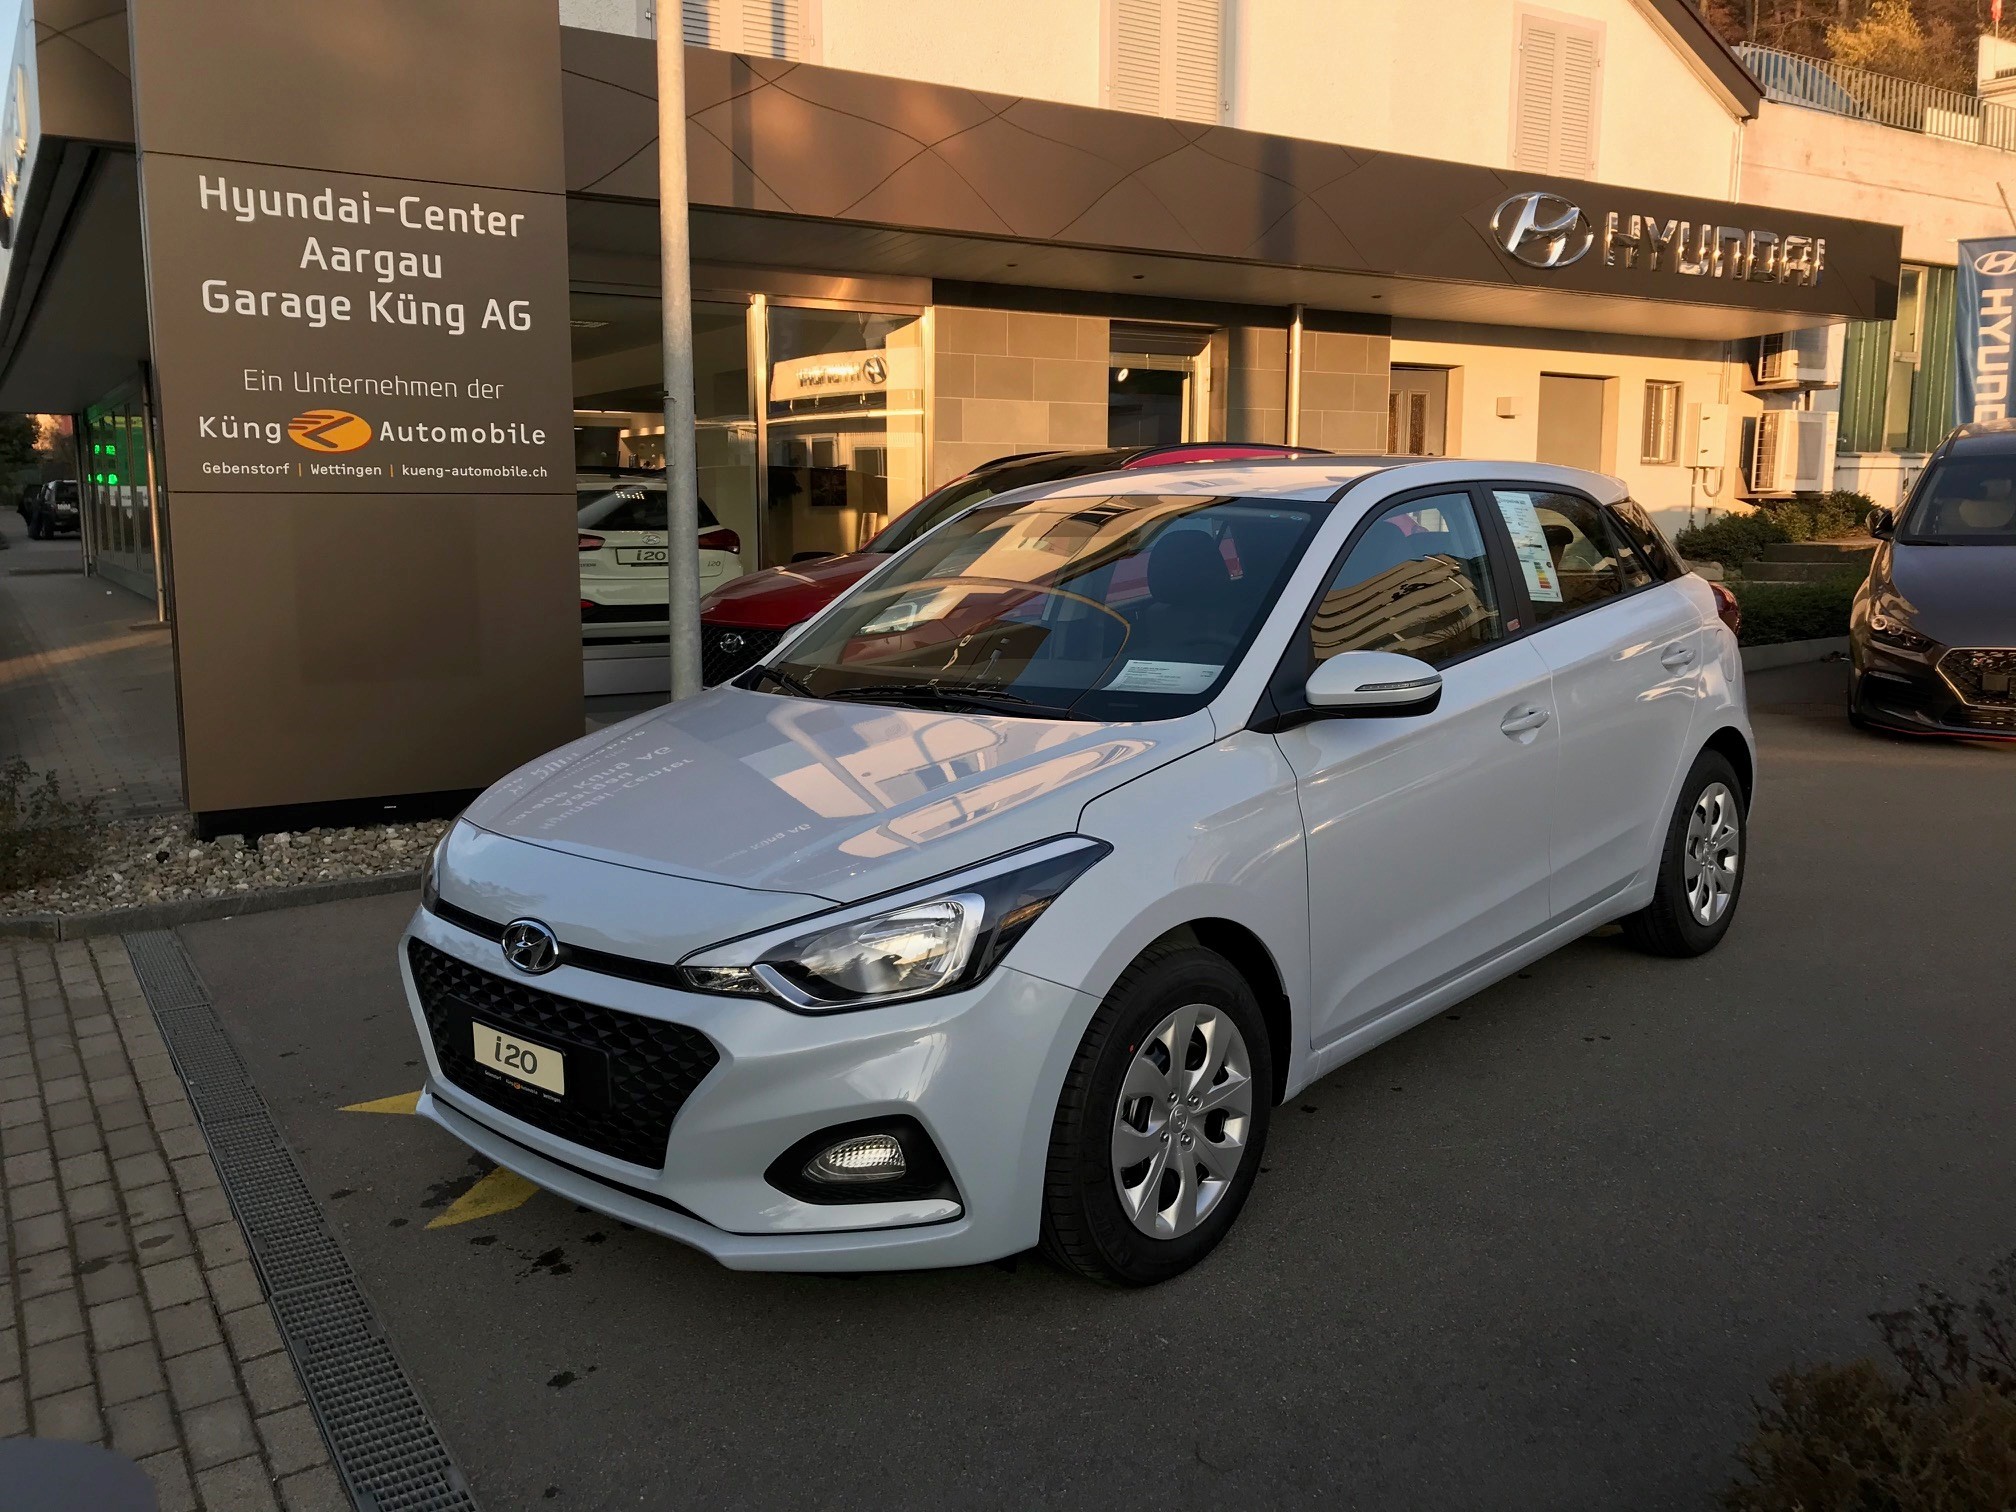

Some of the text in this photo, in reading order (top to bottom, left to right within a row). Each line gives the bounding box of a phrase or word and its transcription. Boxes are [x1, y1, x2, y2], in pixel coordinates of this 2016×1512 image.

[199, 174, 525, 237] Hyundai-Center
[300, 236, 442, 283] Aargau
[1604, 211, 1826, 288] HYUNDAI
[201, 280, 532, 335] Garage Küng AG
[244, 369, 504, 400] Ein Unternehmen der
[199, 416, 546, 445] Küng Automobile
[202, 461, 548, 478] Gebenstorf Wettingen kueng-automobile.ch
[636, 549, 667, 561] i20
[494, 1036, 538, 1075] i20
